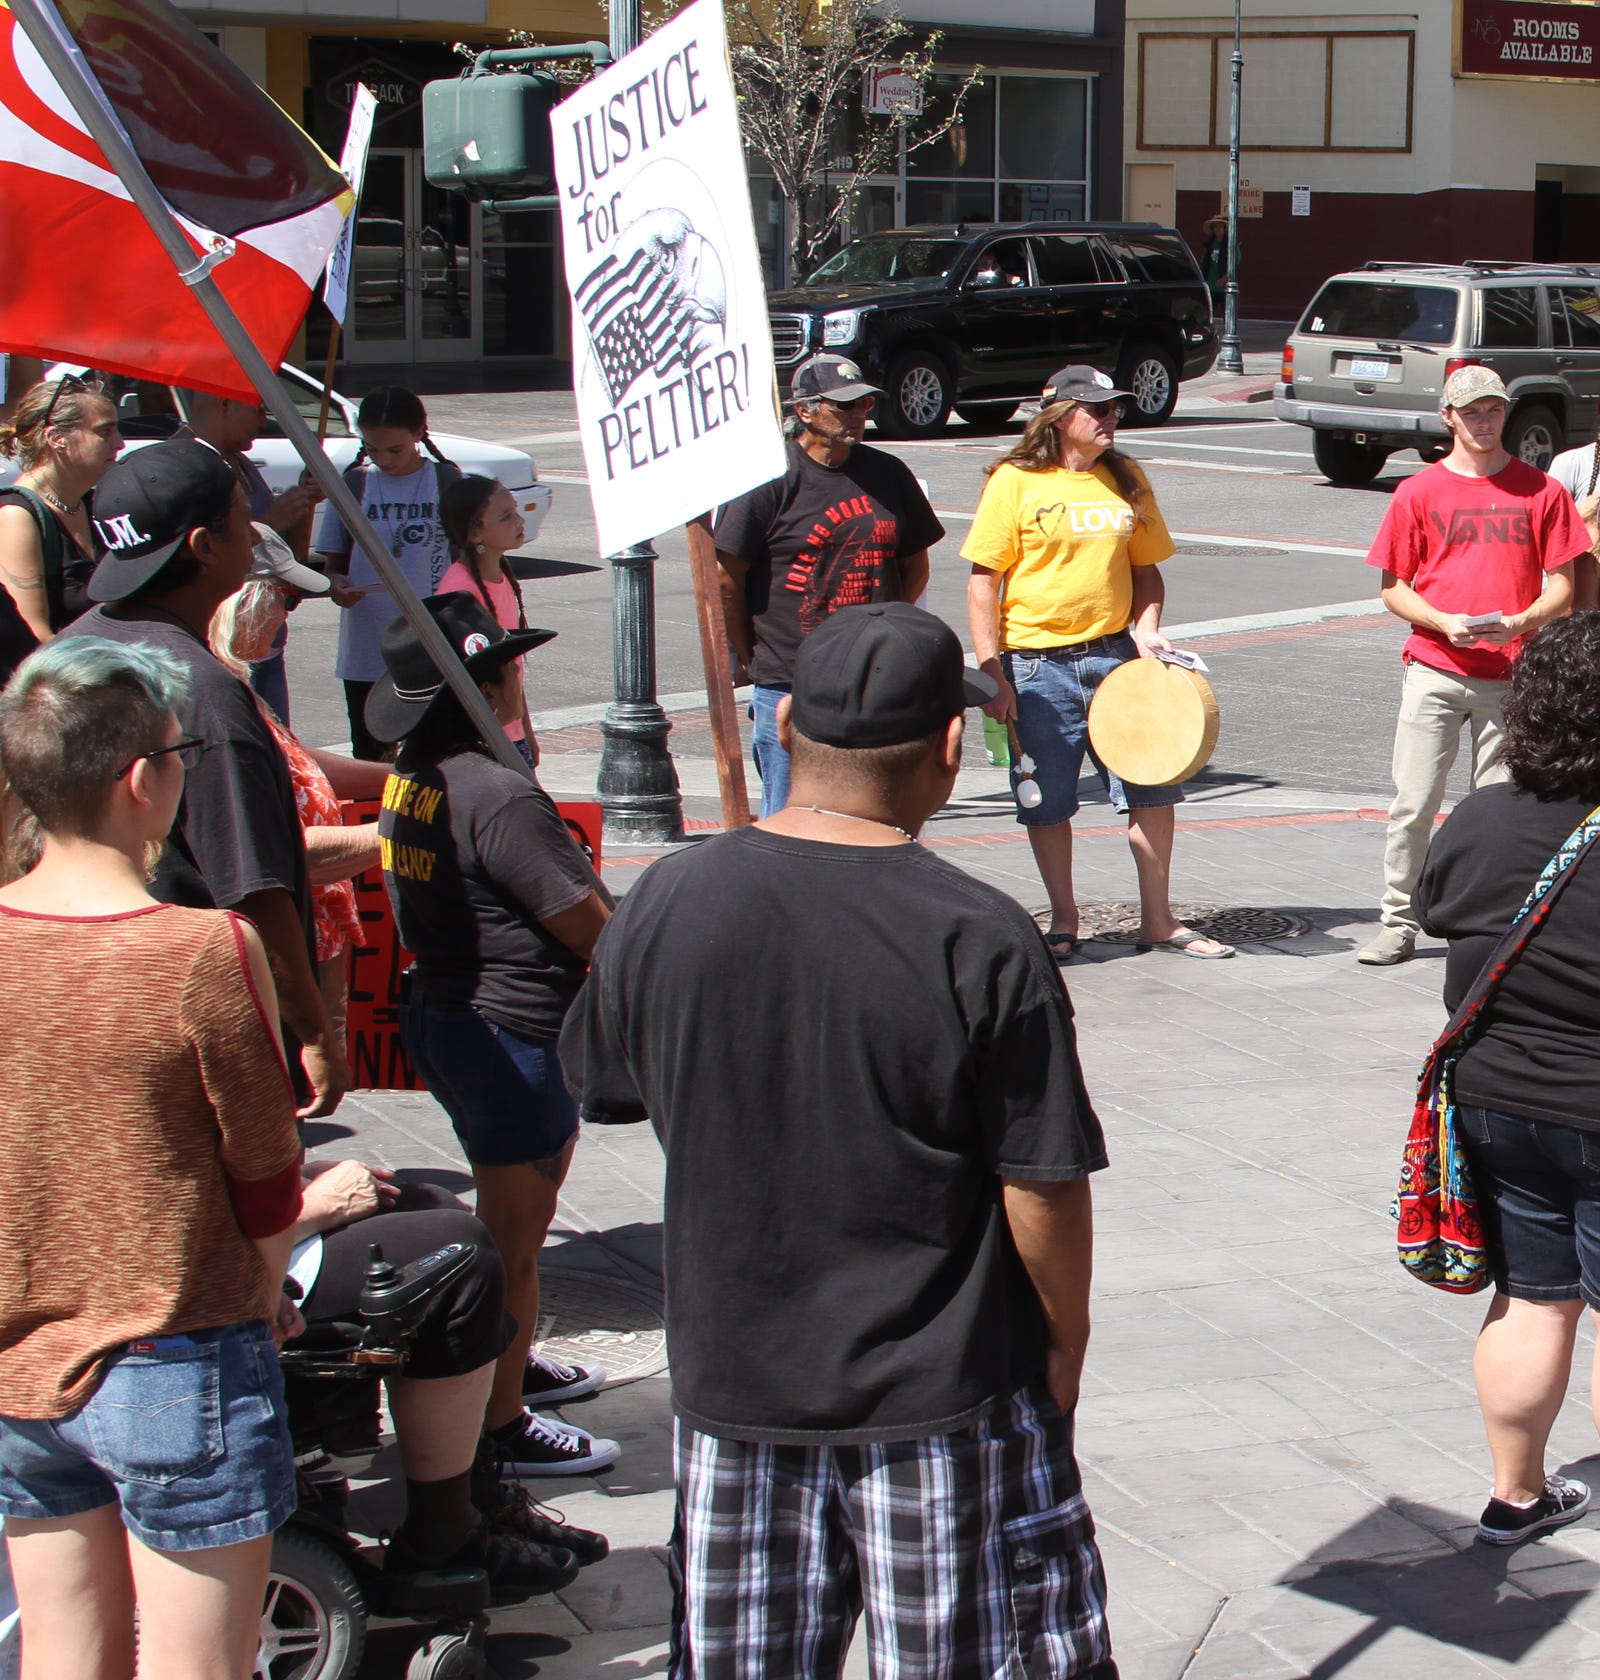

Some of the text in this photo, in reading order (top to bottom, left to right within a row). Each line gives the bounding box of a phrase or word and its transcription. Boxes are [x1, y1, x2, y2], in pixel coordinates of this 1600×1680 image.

[1499, 41, 1592, 64] AVAILABLE
[1513, 18, 1580, 41] ROOMS
[568, 39, 708, 200] JUSTICE
[576, 190, 622, 253] for
[597, 342, 750, 481] PELTIER!
[366, 502, 435, 521] AYTON
[1430, 507, 1534, 546] VANS
[784, 552, 818, 592] IDLE
[824, 495, 874, 526] MORE
